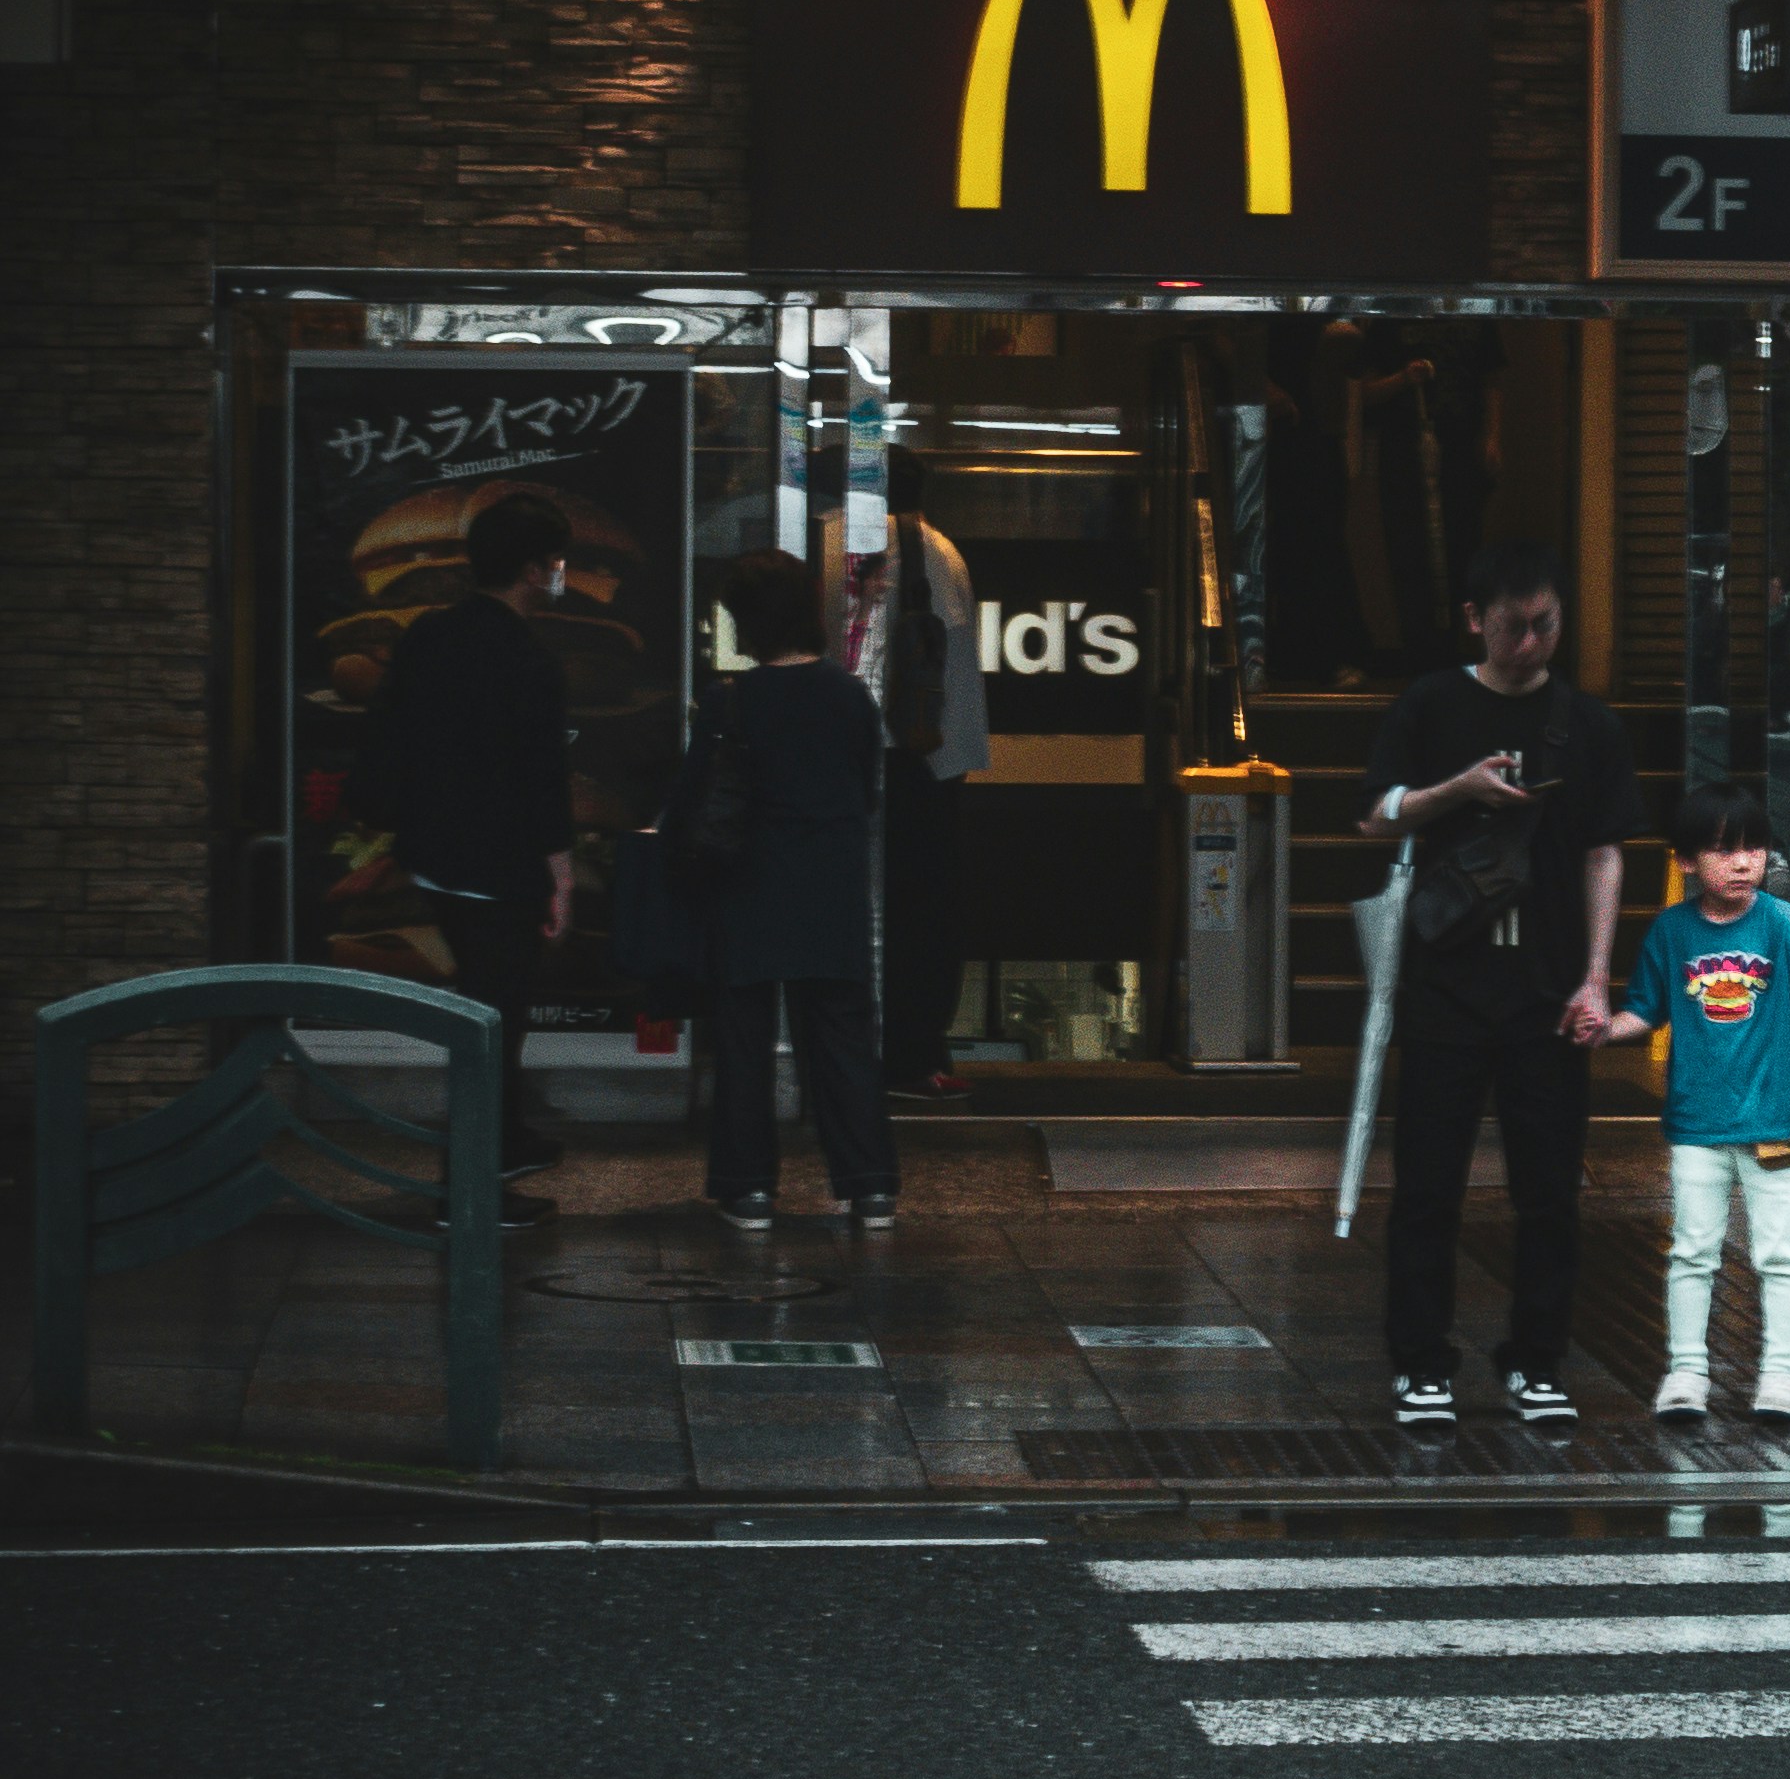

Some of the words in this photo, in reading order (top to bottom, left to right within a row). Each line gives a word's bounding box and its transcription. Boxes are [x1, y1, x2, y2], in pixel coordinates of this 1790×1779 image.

[1654, 154, 1751, 233] 2F
[327, 376, 648, 478] サムライマック
[977, 599, 1140, 676] ld's
